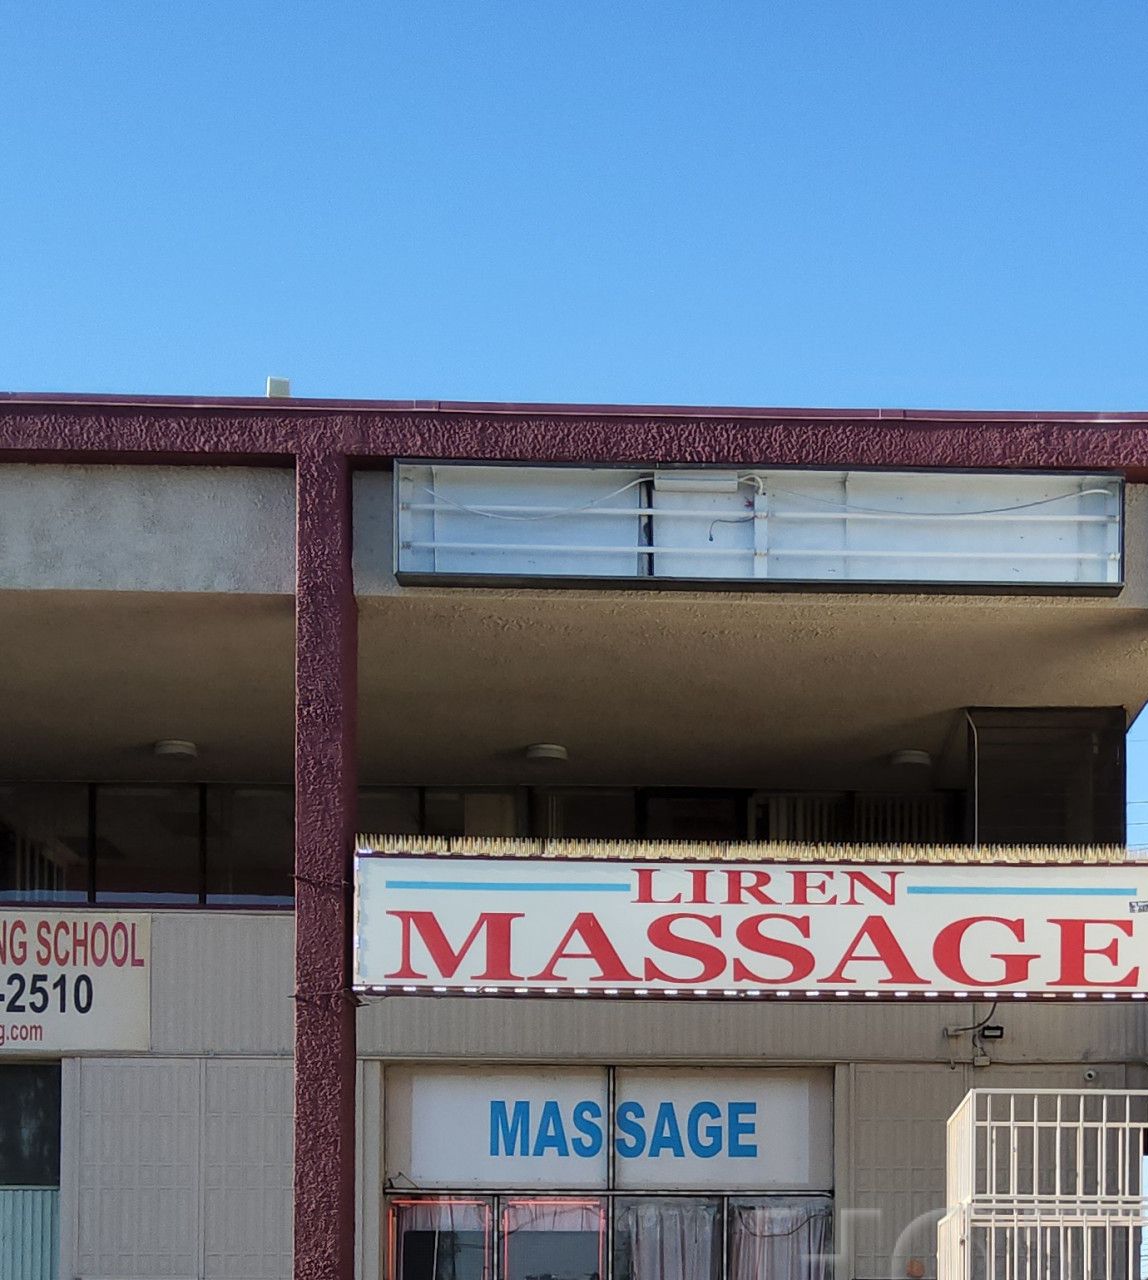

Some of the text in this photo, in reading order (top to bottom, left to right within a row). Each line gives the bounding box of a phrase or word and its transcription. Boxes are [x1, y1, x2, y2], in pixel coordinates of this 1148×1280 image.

[630, 868, 906, 907] LIREN
[36, 920, 145, 968] SCHOOL
[384, 910, 1142, 988] MASSAGE
[489, 1100, 758, 1158] MASSAGE
